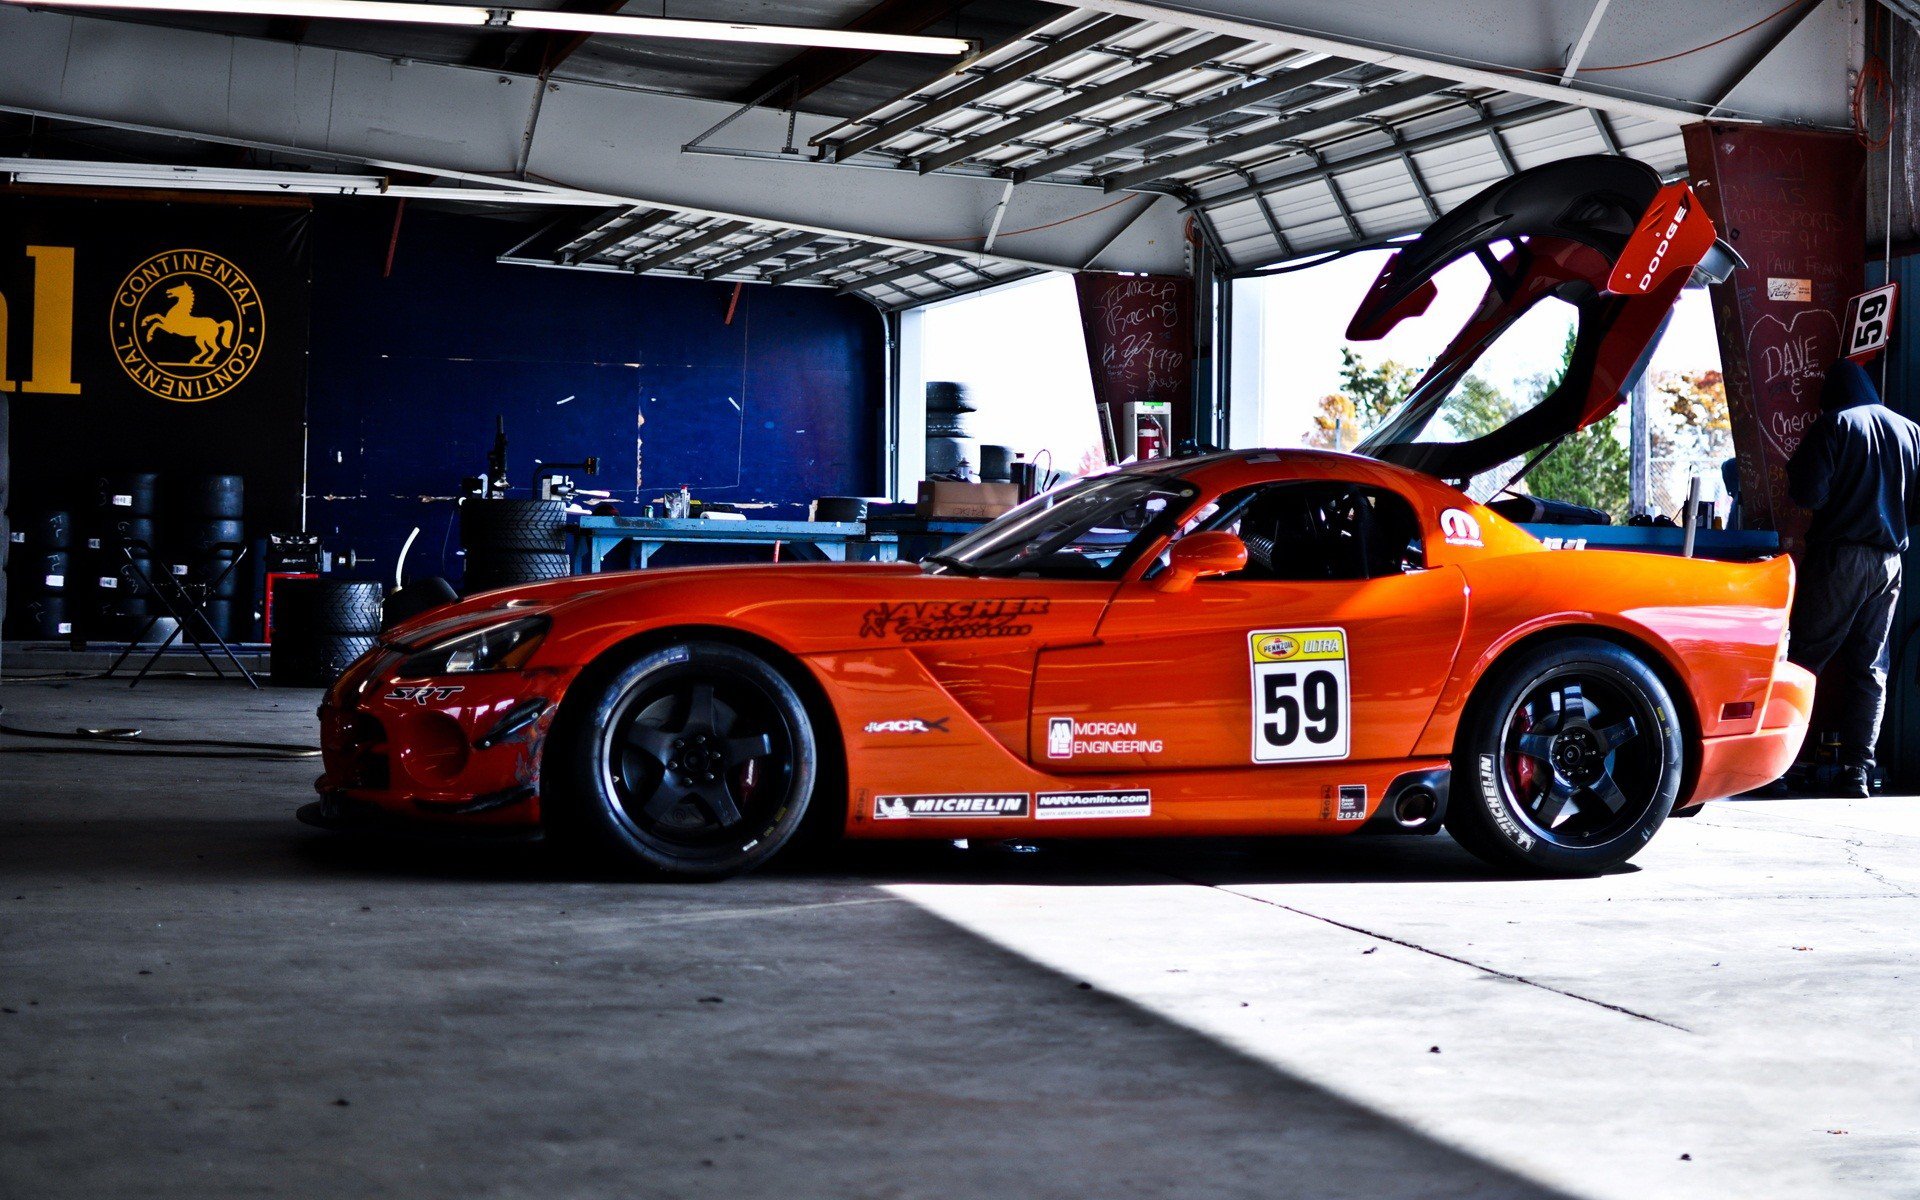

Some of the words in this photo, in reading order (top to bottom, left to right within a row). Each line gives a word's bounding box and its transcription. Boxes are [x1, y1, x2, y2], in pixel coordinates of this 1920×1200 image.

[1639, 205, 1688, 291] DODGE
[119, 254, 256, 315] CONTINENTAL
[1855, 293, 1888, 349] 59
[118, 335, 255, 397] CONTINENTAL
[1761, 335, 1818, 383] DAVE
[887, 597, 1051, 621] ARCHER
[1264, 640, 1294, 653] PENNZOIL
[1303, 638, 1340, 654] ULTRA
[384, 686, 465, 705] SRT
[1263, 669, 1340, 747] 59
[1073, 740, 1163, 754] ENGINEERING
[1074, 722, 1136, 736] MORGAN
[913, 798, 1022, 812] MICHELIN
[1039, 795, 1147, 805] NARRAonline.com
[1481, 756, 1518, 837] MICHELIN
